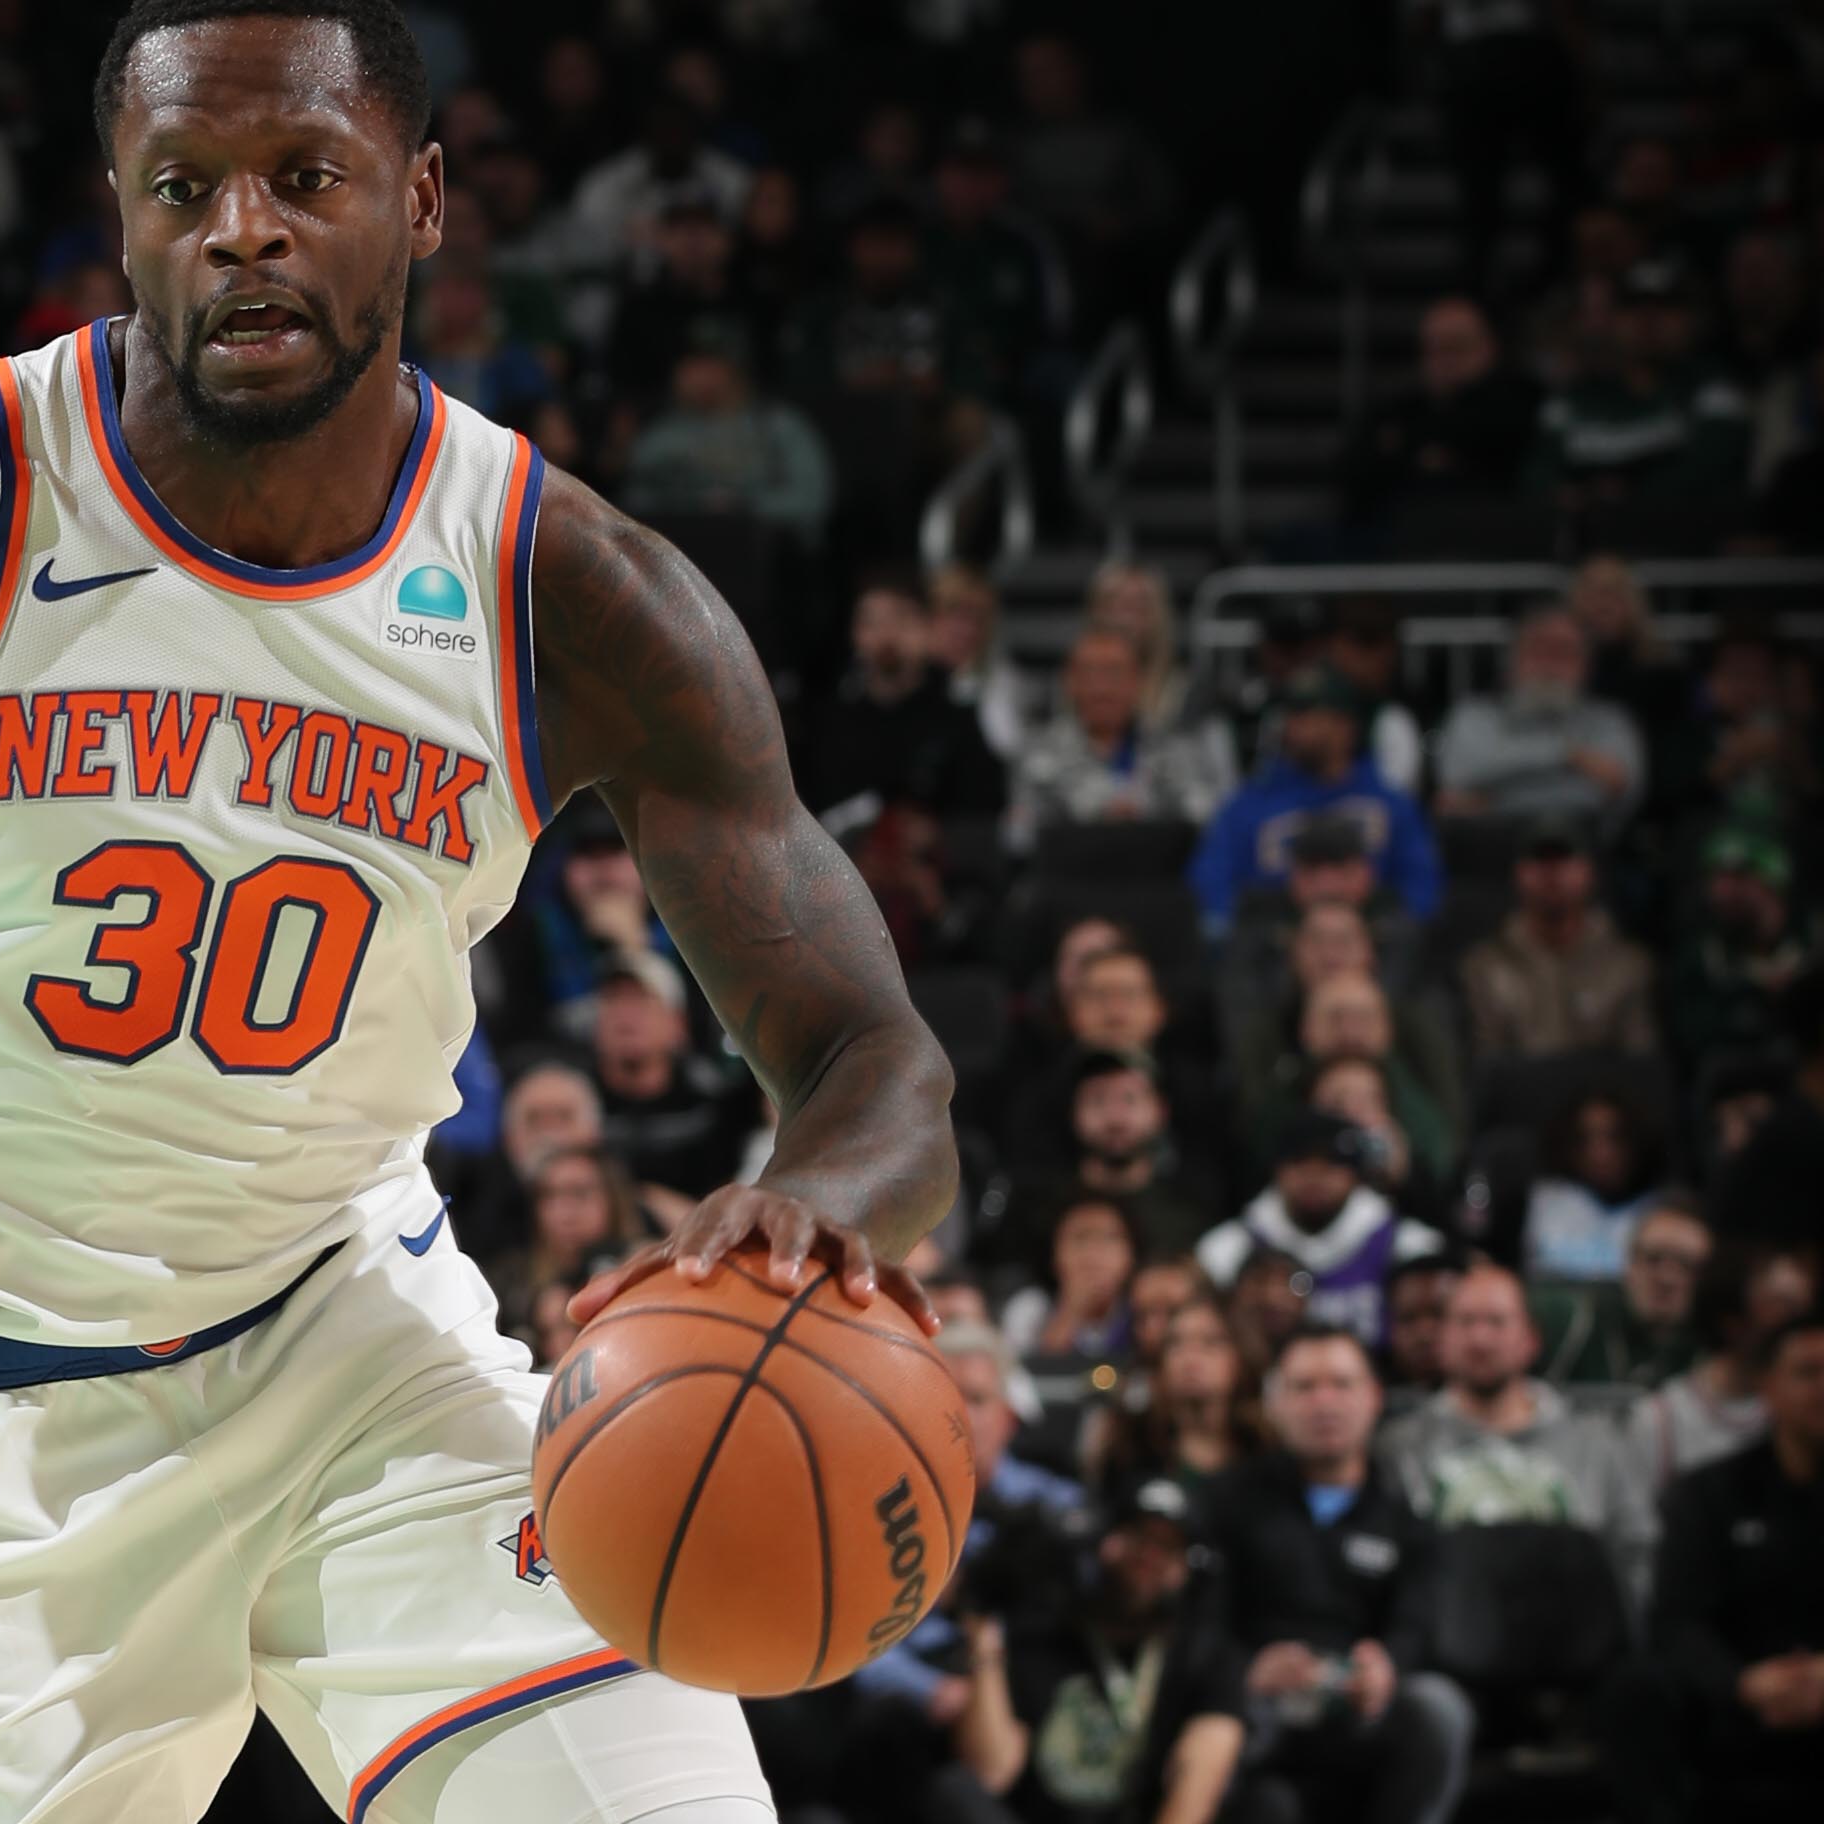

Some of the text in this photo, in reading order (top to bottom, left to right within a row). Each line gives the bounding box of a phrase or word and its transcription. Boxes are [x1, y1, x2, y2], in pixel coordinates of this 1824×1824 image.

[386, 623, 476, 654] sphere
[232, 693, 489, 866] YORK
[23, 839, 383, 1076] 30
